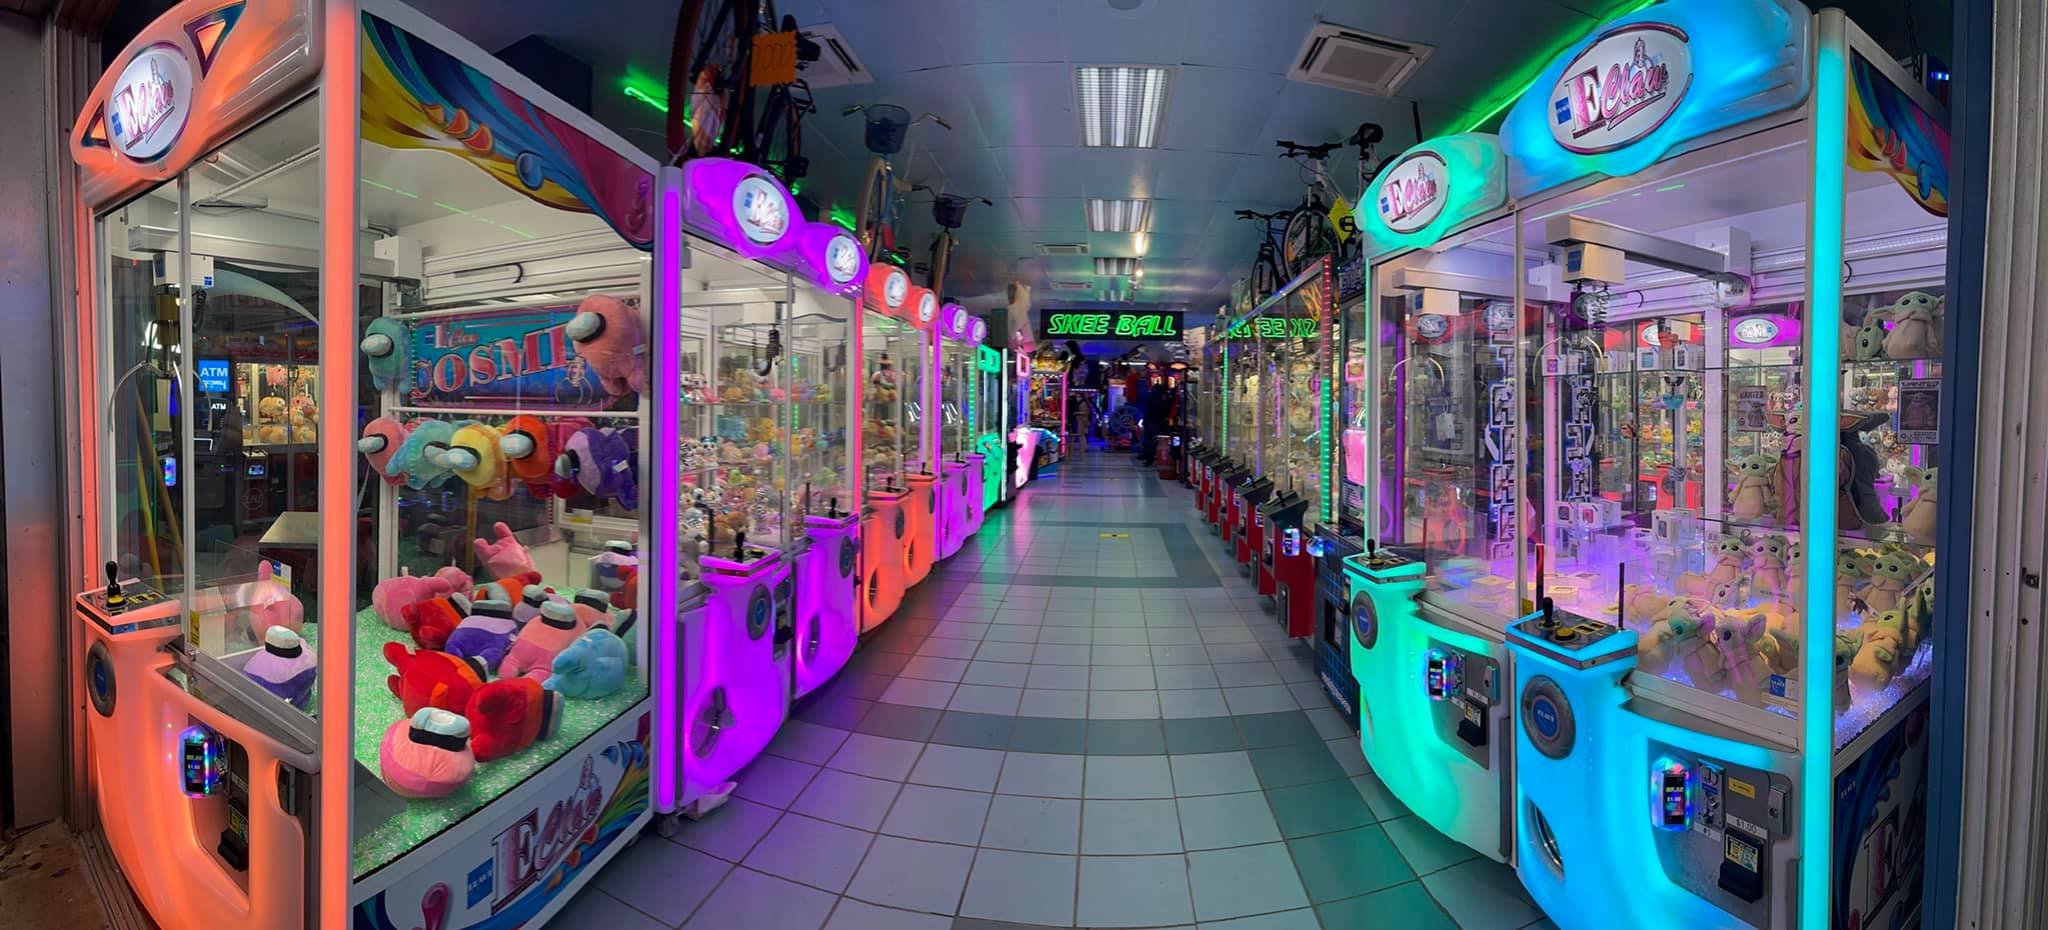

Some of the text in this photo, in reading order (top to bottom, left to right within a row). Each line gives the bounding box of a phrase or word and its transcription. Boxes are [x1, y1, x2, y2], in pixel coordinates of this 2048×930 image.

[1048, 313, 1177, 337] SKEE BALL
[200, 367, 229, 377] ATM
[1735, 818, 1757, 835] $1.00
